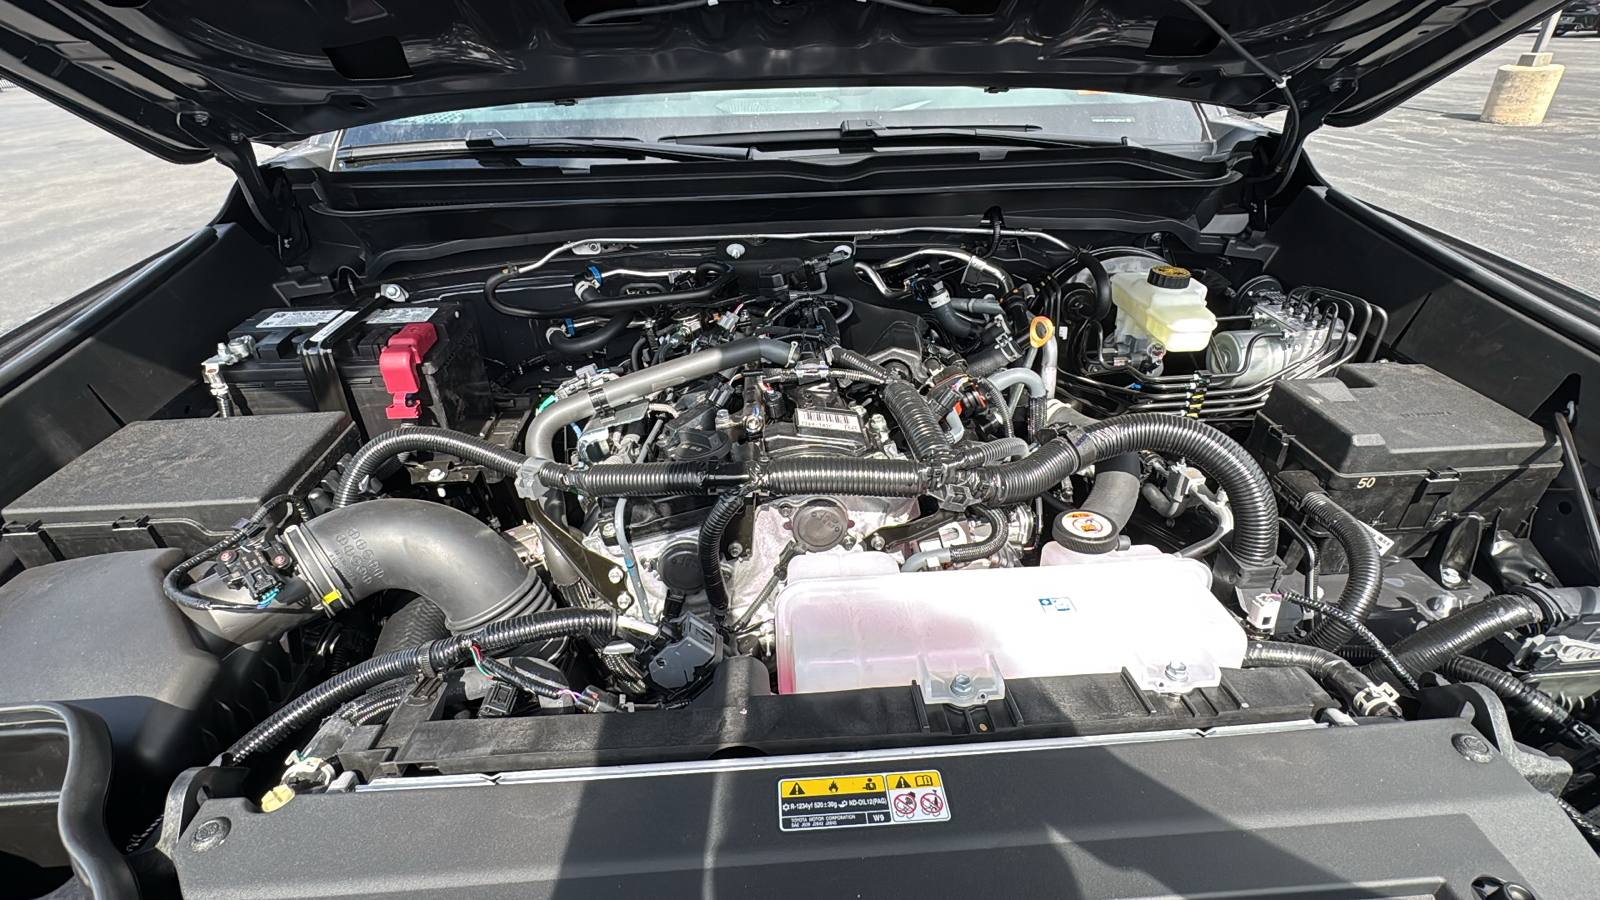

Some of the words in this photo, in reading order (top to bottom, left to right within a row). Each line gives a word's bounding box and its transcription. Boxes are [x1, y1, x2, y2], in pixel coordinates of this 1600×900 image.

[1357, 477, 1376, 489] 50
[791, 802, 813, 810] R-1234yf
[872, 814, 885, 822] W9
